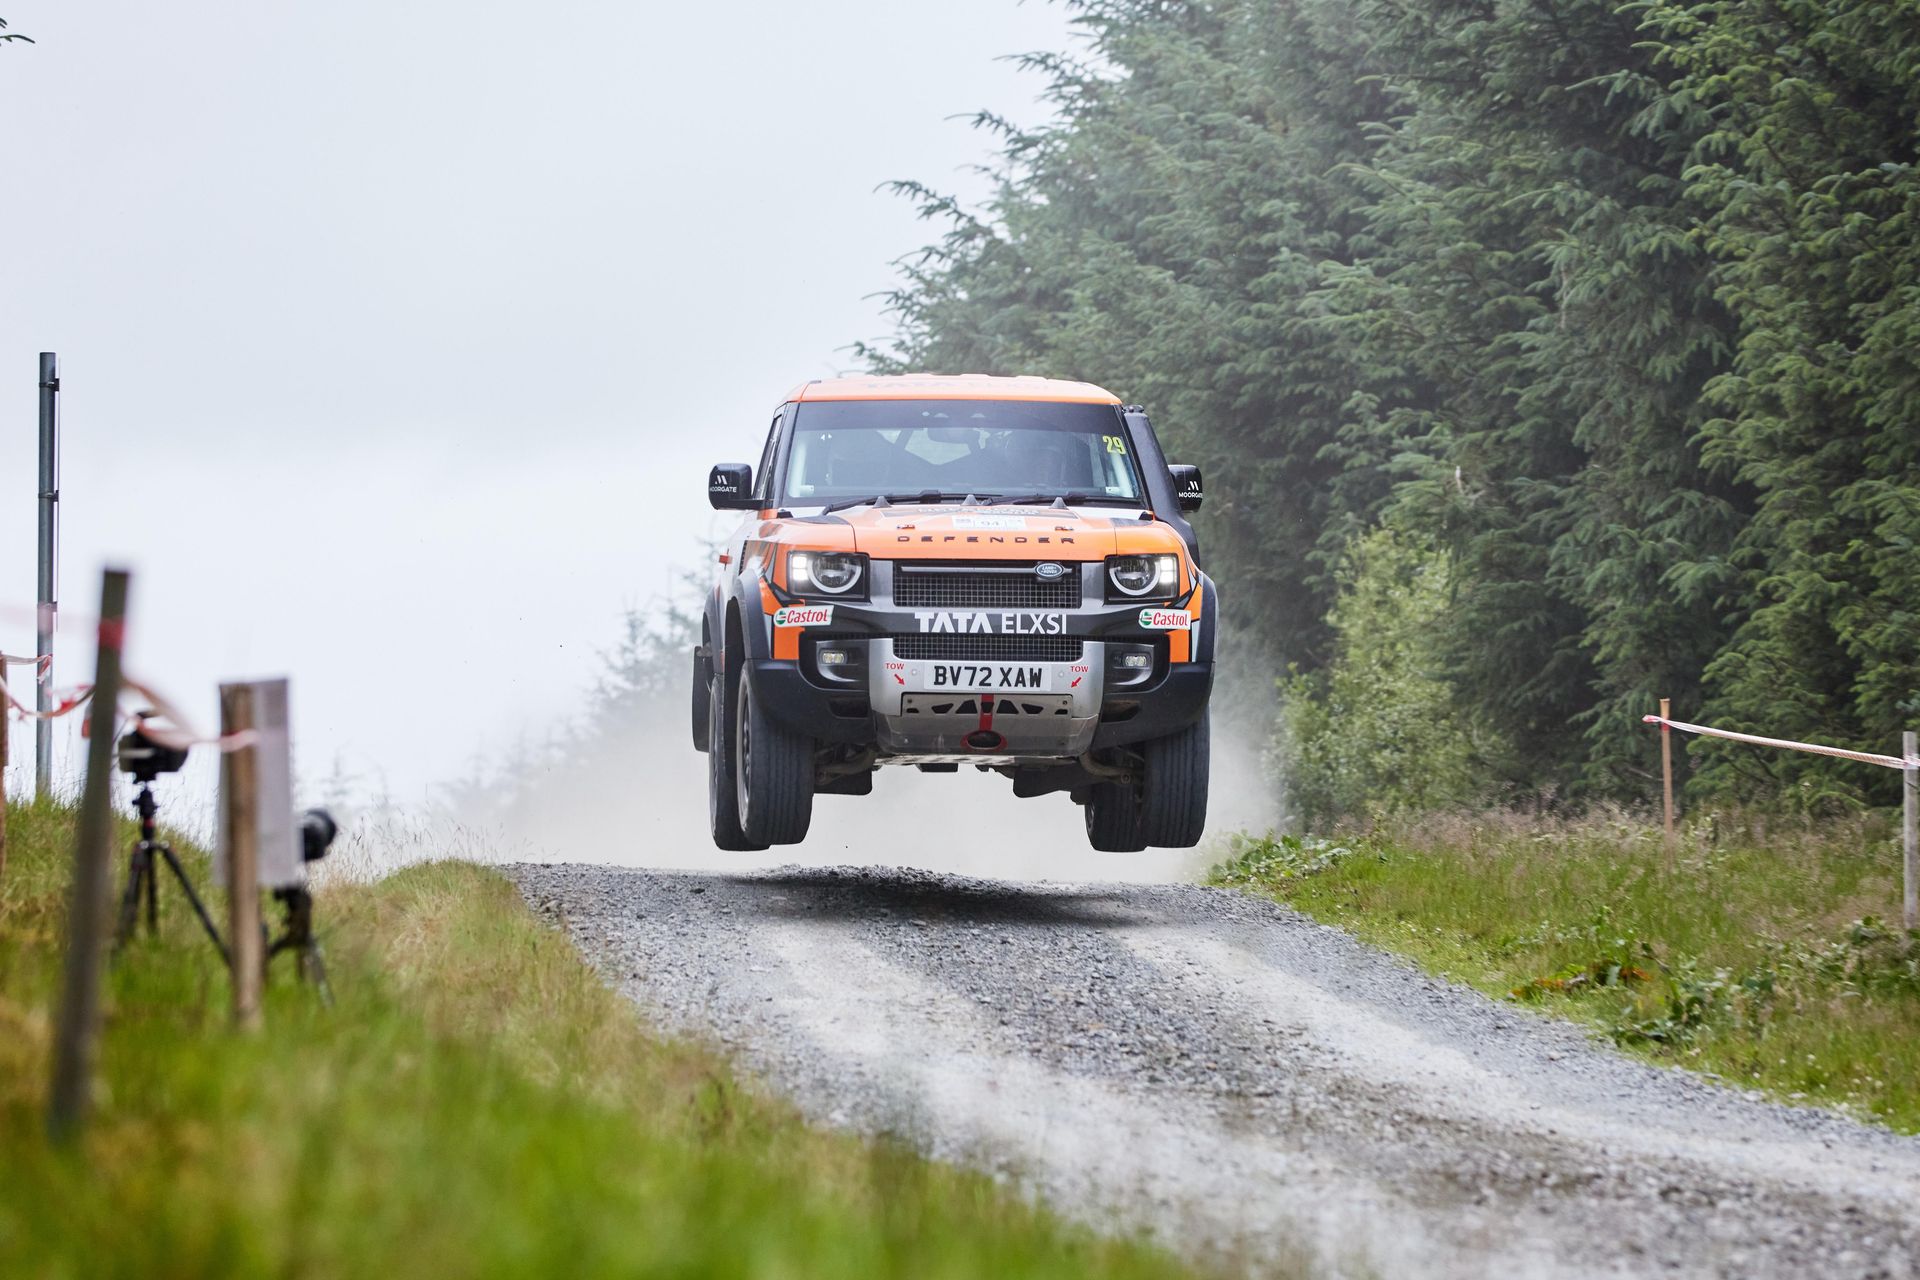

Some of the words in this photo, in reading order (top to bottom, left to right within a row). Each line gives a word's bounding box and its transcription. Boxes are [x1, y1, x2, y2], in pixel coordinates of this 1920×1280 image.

[1102, 435, 1126, 455] 29
[897, 535, 1075, 544] DEFENDER
[787, 609, 828, 624] Castrol
[914, 612, 993, 634] TATA
[1001, 613, 1067, 635] ELXSI
[1153, 612, 1188, 626] Castrol
[885, 662, 905, 670] TOW
[1070, 665, 1089, 673] TOW
[933, 665, 992, 687] BV72
[999, 667, 1042, 688] XAW
